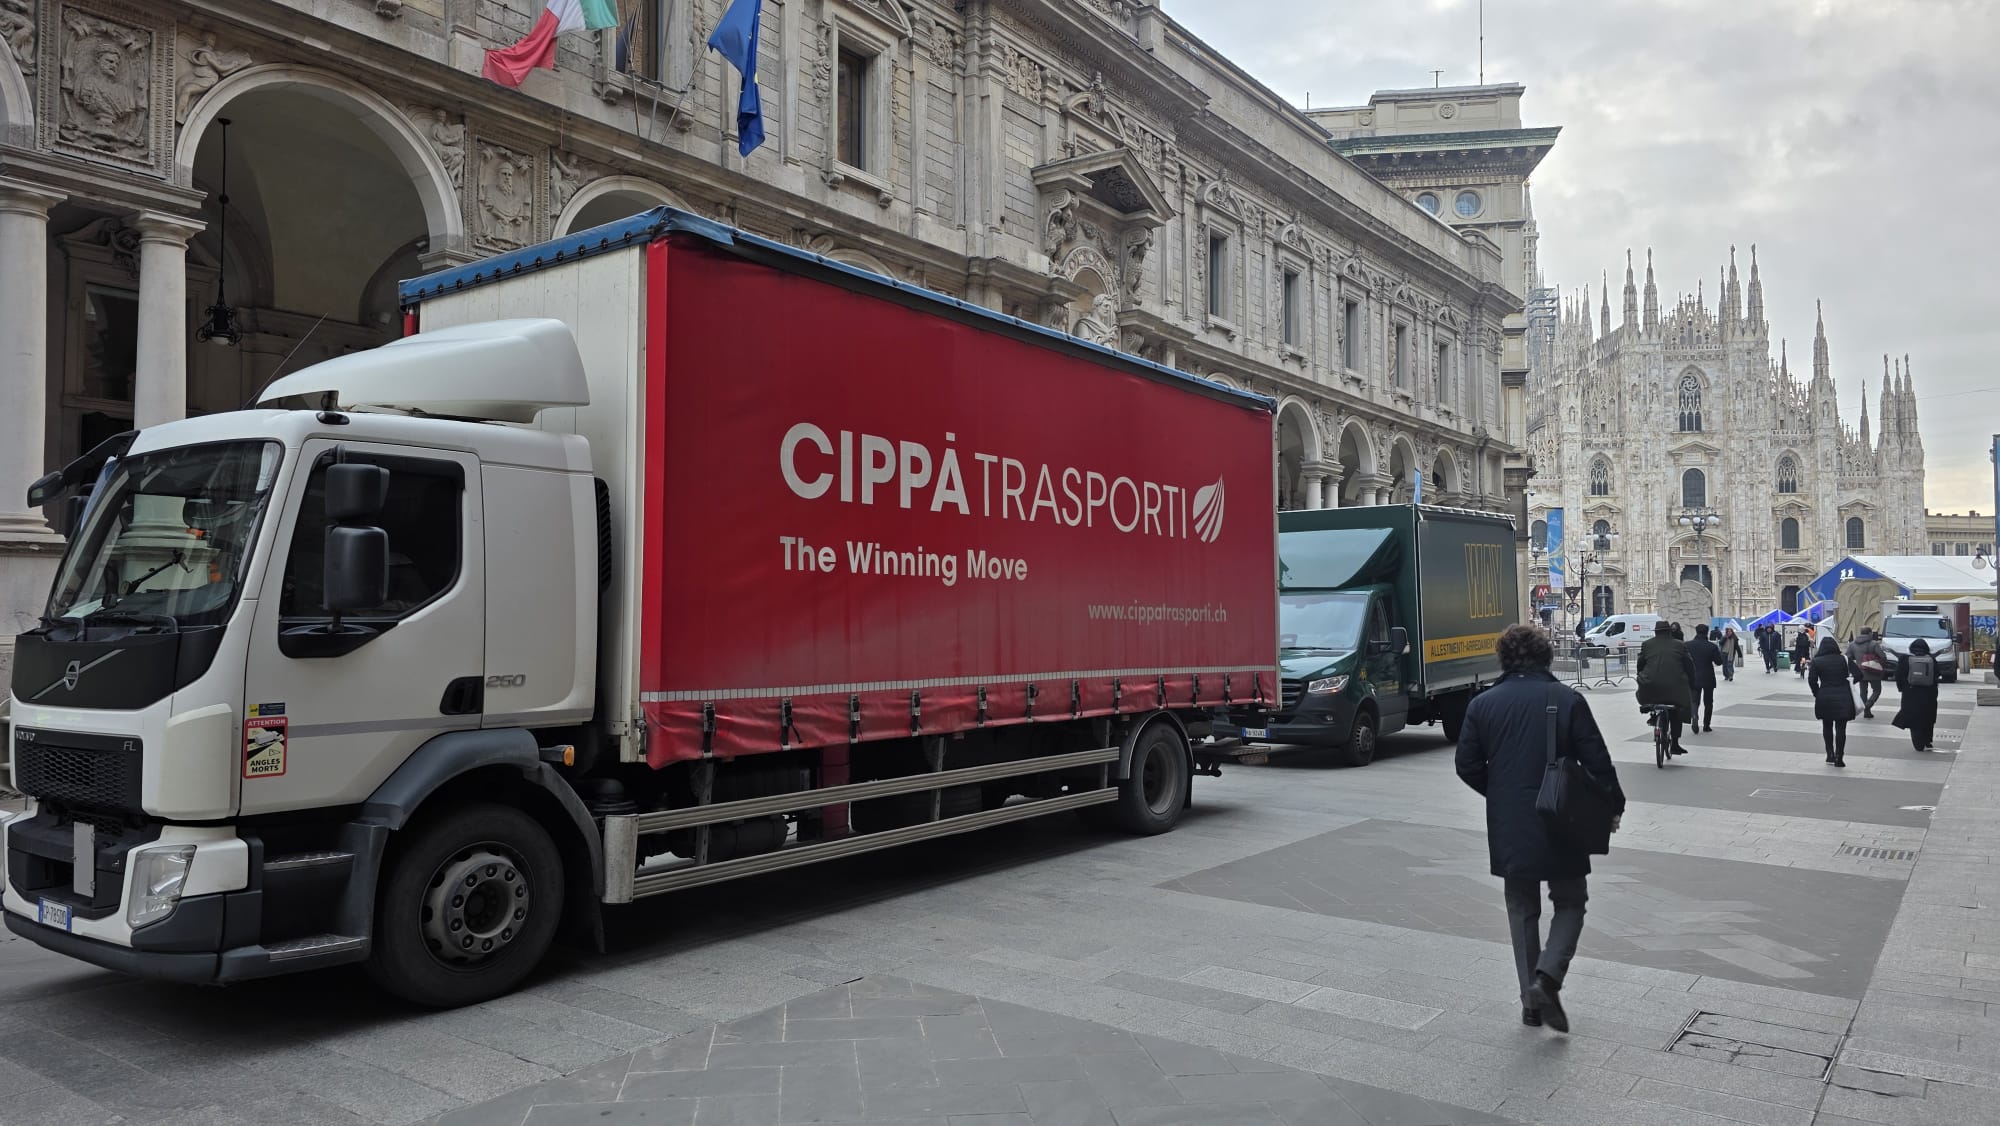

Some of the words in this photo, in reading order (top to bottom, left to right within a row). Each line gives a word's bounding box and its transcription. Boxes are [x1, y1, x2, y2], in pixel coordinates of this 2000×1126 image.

[974, 452, 1187, 539] TRASPORTI
[780, 536, 837, 573] The
[846, 541, 957, 587] Winning
[967, 549, 1028, 581] Move
[1464, 543, 1503, 619] WAY
[1088, 599, 1227, 626] www.cippatrasporti.ch
[248, 719, 286, 727] ATTENTION
[123, 740, 137, 752] FL
[250, 758, 281, 767] ANGLES
[251, 765, 279, 774] MORTS
